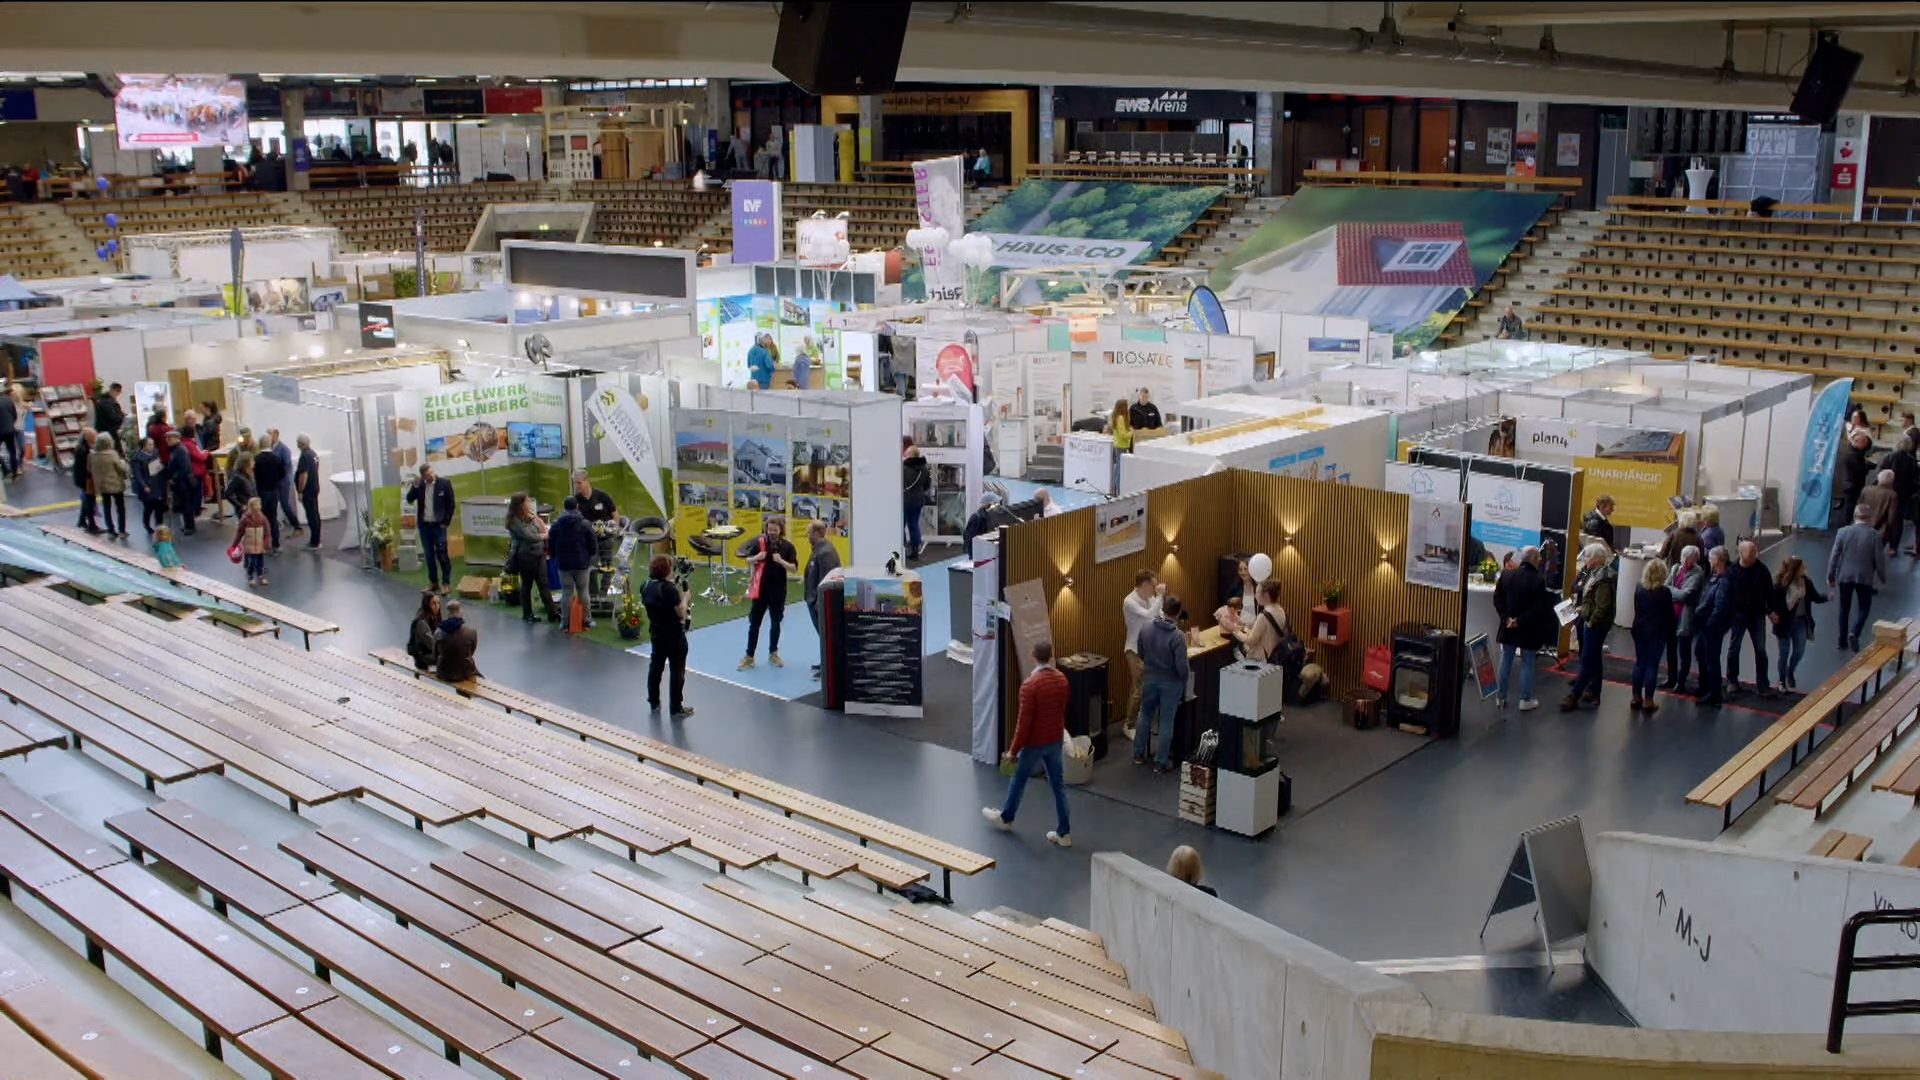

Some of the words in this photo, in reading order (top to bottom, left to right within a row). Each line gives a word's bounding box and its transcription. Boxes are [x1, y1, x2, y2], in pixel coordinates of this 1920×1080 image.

[1150, 97, 1188, 113] Arena
[1116, 350, 1174, 368] BOSATEC
[423, 383, 528, 408] ZIEGELWERK
[425, 396, 529, 422] BELLENBERG
[1675, 906, 1711, 962] M-J
